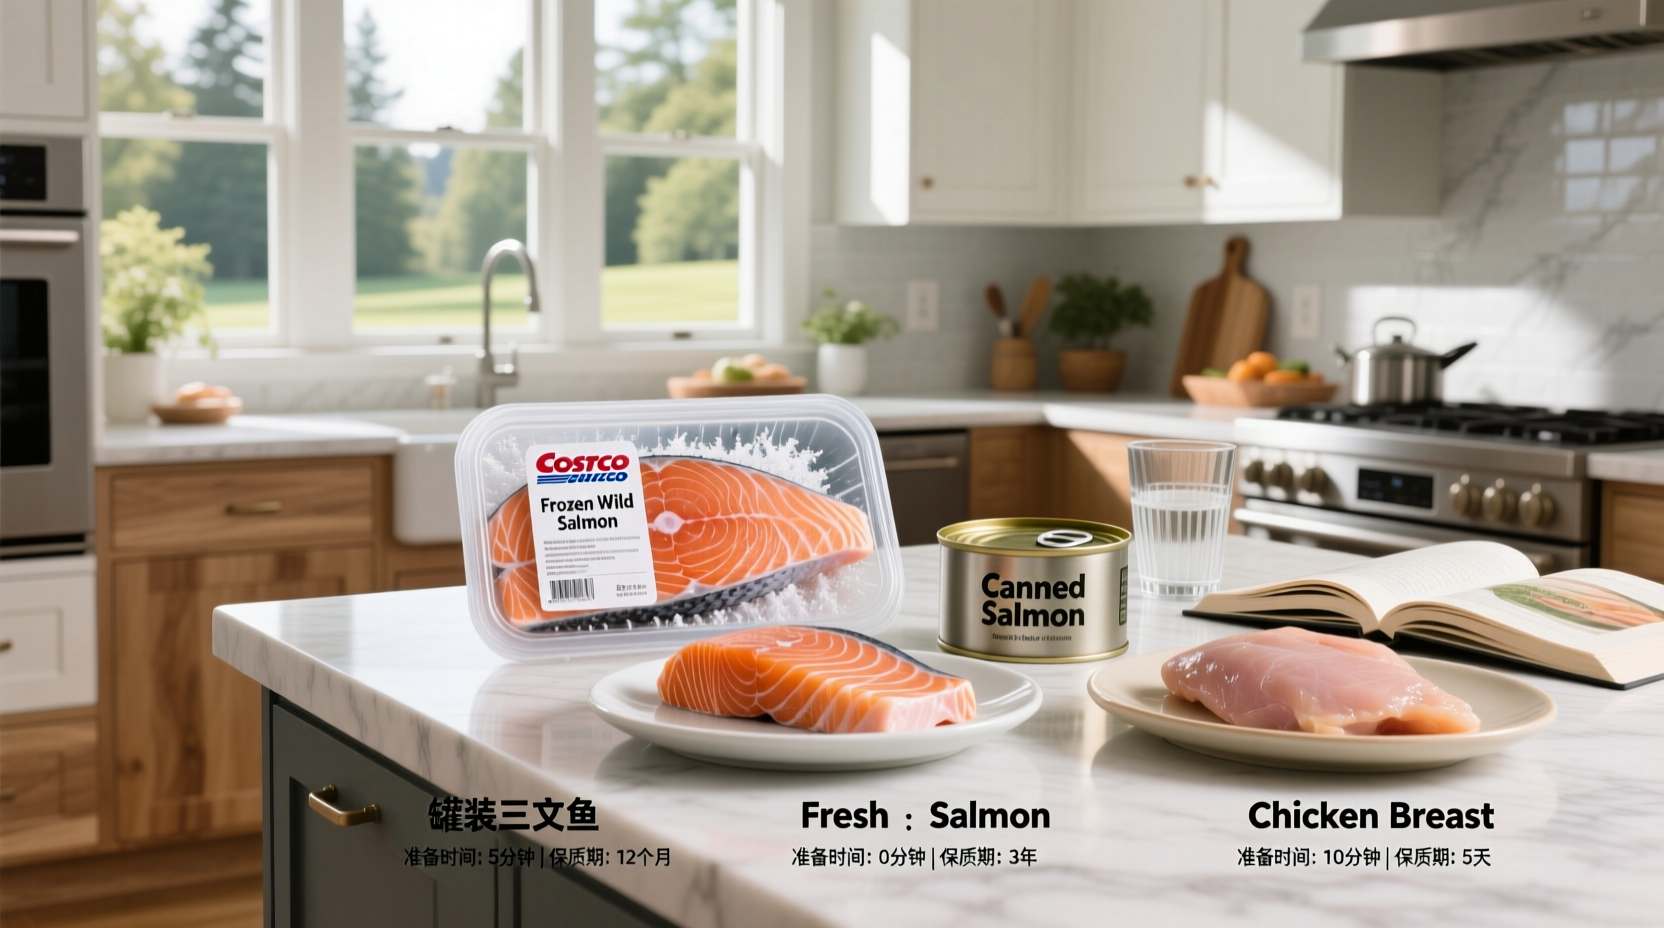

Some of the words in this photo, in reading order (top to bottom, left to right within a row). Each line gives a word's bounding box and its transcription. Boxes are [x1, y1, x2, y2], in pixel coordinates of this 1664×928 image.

[541, 498, 594, 513] Frozen
[597, 493, 634, 510] Wild
[557, 514, 618, 531] Salmon
[981, 572, 1085, 600] Canned
[981, 600, 1085, 627] Salmon
